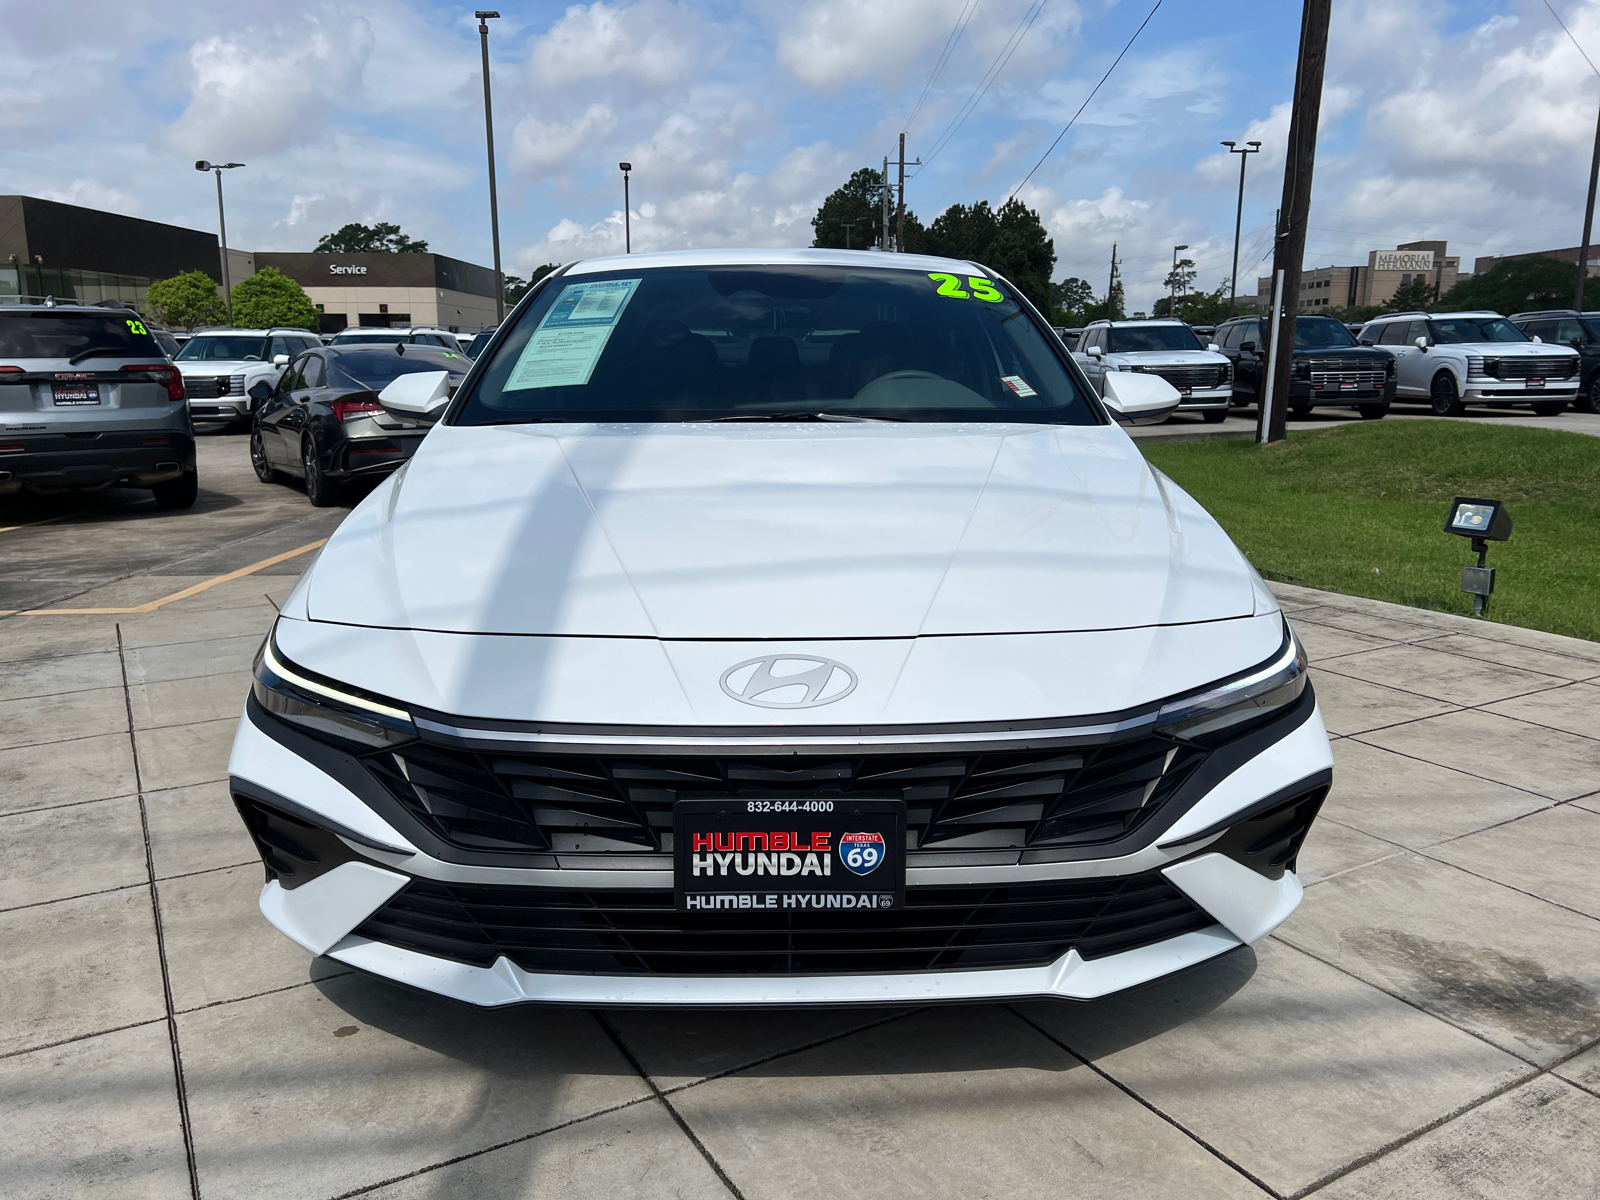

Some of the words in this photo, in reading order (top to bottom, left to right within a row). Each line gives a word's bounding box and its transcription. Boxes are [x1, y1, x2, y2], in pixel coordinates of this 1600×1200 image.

[1377, 261, 1431, 270] HERMANN
[1379, 254, 1430, 262] MEMORIAL
[329, 264, 367, 275] Service
[928, 273, 1004, 303] 25
[126, 320, 147, 335] 23
[747, 801, 834, 812] 832-644-4000
[692, 832, 831, 851] HUMBLE
[692, 852, 831, 876] HYUNDAI
[847, 847, 878, 867] 69
[686, 894, 778, 909] HUMBLE
[782, 894, 877, 908] HYUNDAI
